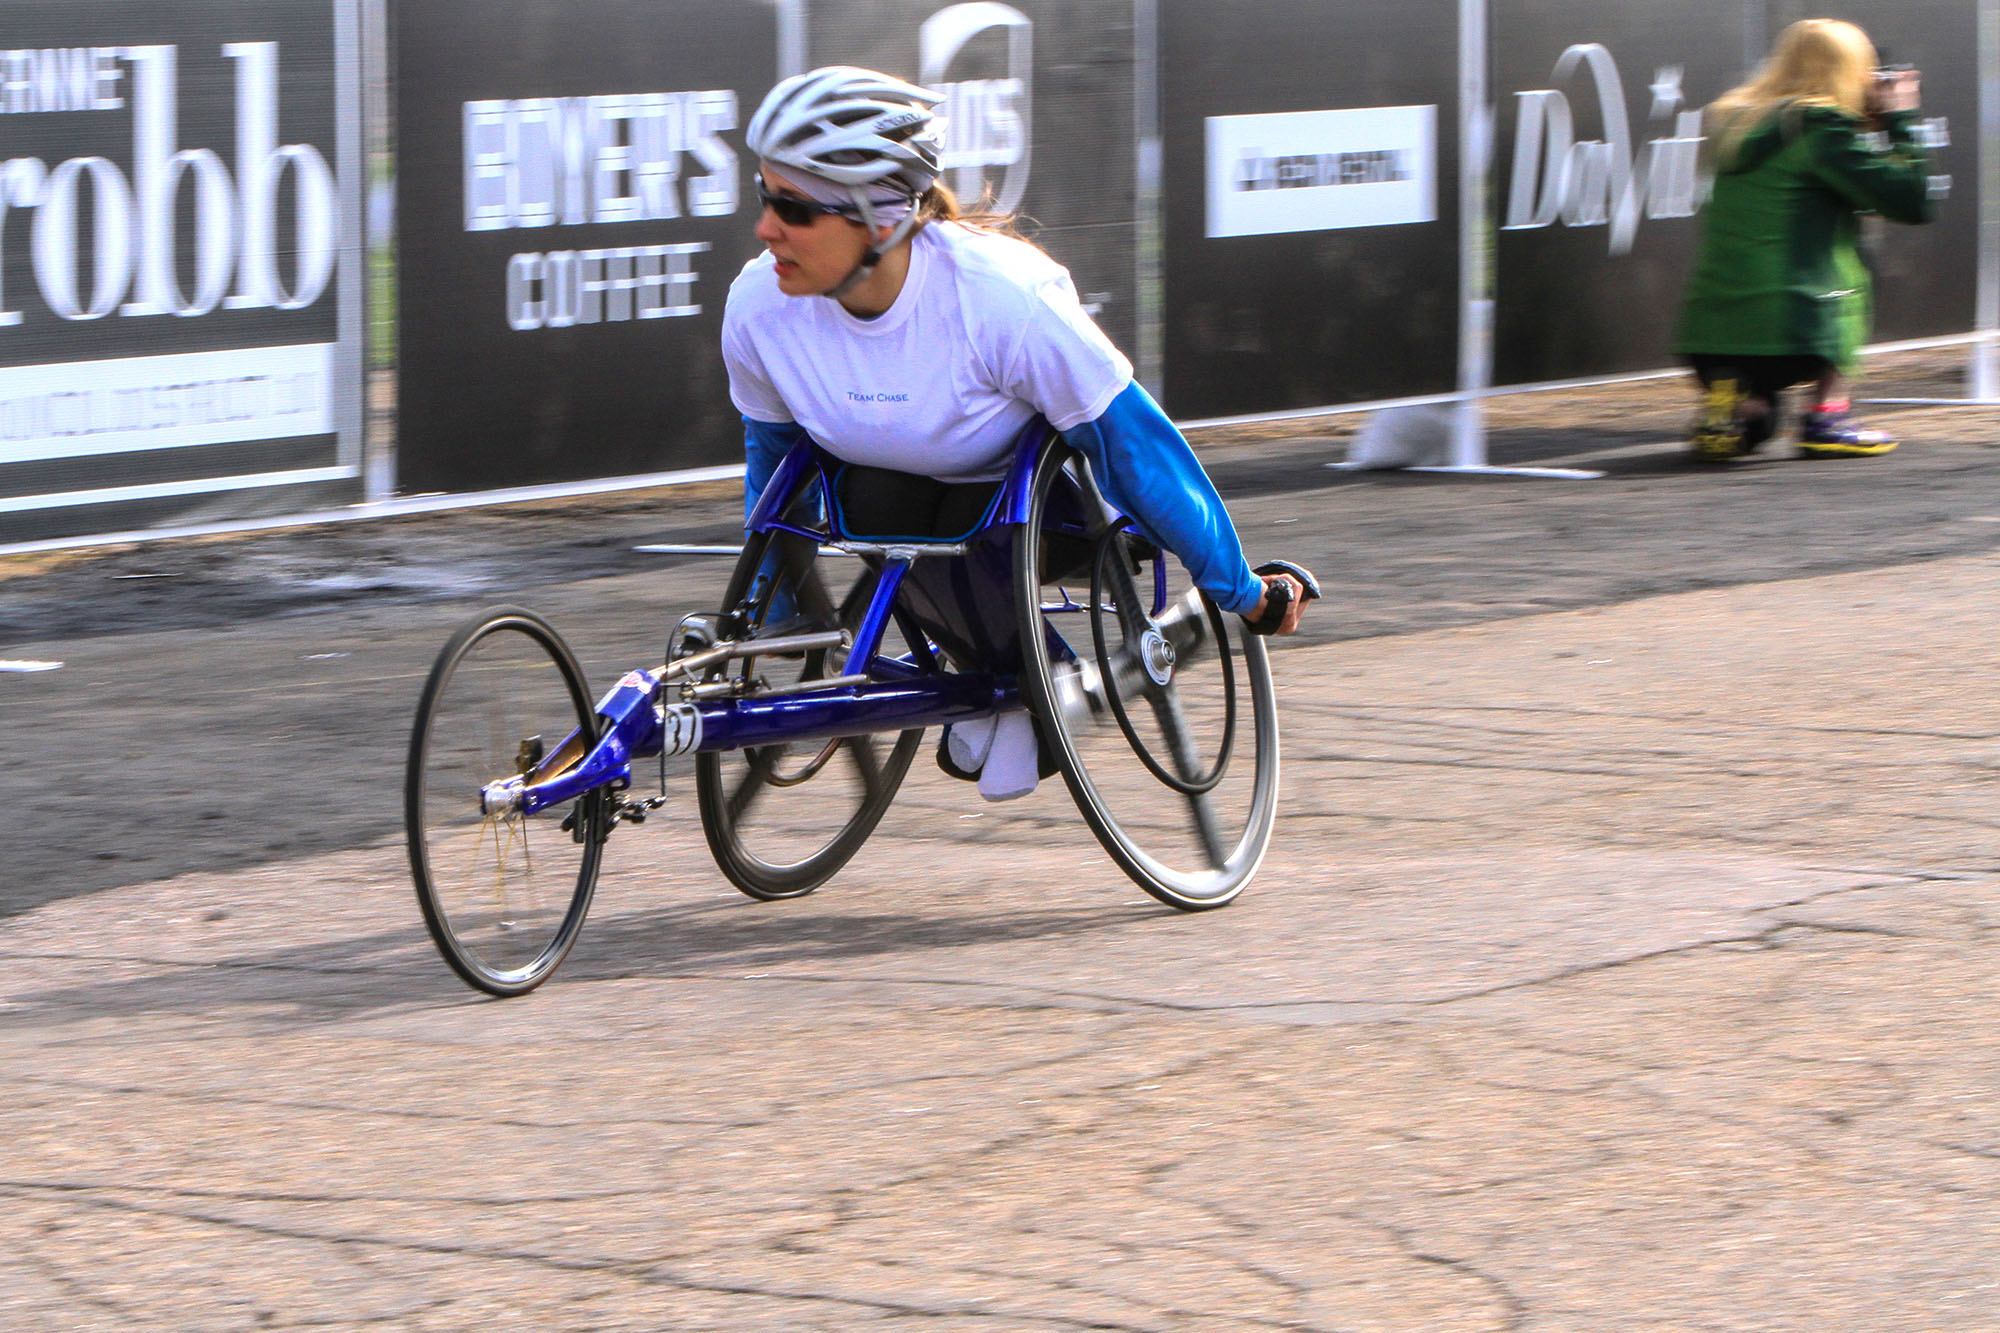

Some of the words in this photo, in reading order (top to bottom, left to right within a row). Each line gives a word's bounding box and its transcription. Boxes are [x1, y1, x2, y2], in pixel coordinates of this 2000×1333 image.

[1501, 43, 1714, 256] DaVit
[507, 241, 712, 330] COFFEE
[847, 391, 874, 402] TEAM
[877, 392, 909, 402] CHASE
